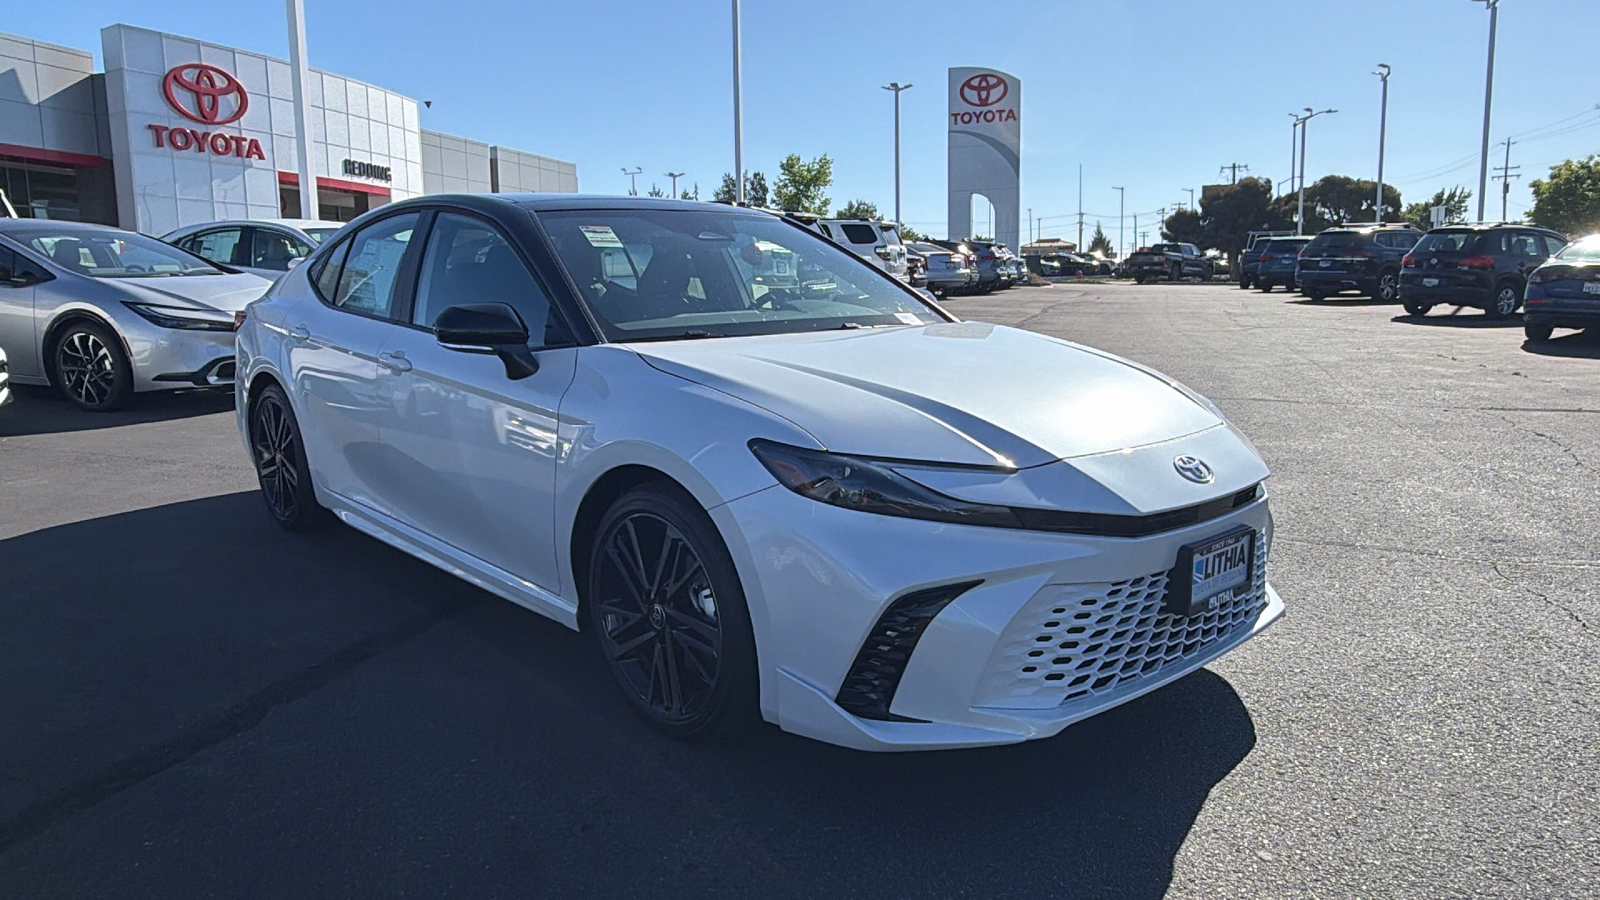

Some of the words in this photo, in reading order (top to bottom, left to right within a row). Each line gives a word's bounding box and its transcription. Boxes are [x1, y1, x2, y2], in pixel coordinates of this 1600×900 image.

[951, 109, 1017, 125] TOYOTA
[148, 124, 265, 160] TOYOTA
[343, 158, 392, 181] REDDING
[1204, 543, 1246, 580] LITHIA
[1214, 588, 1234, 606] LITHIA
